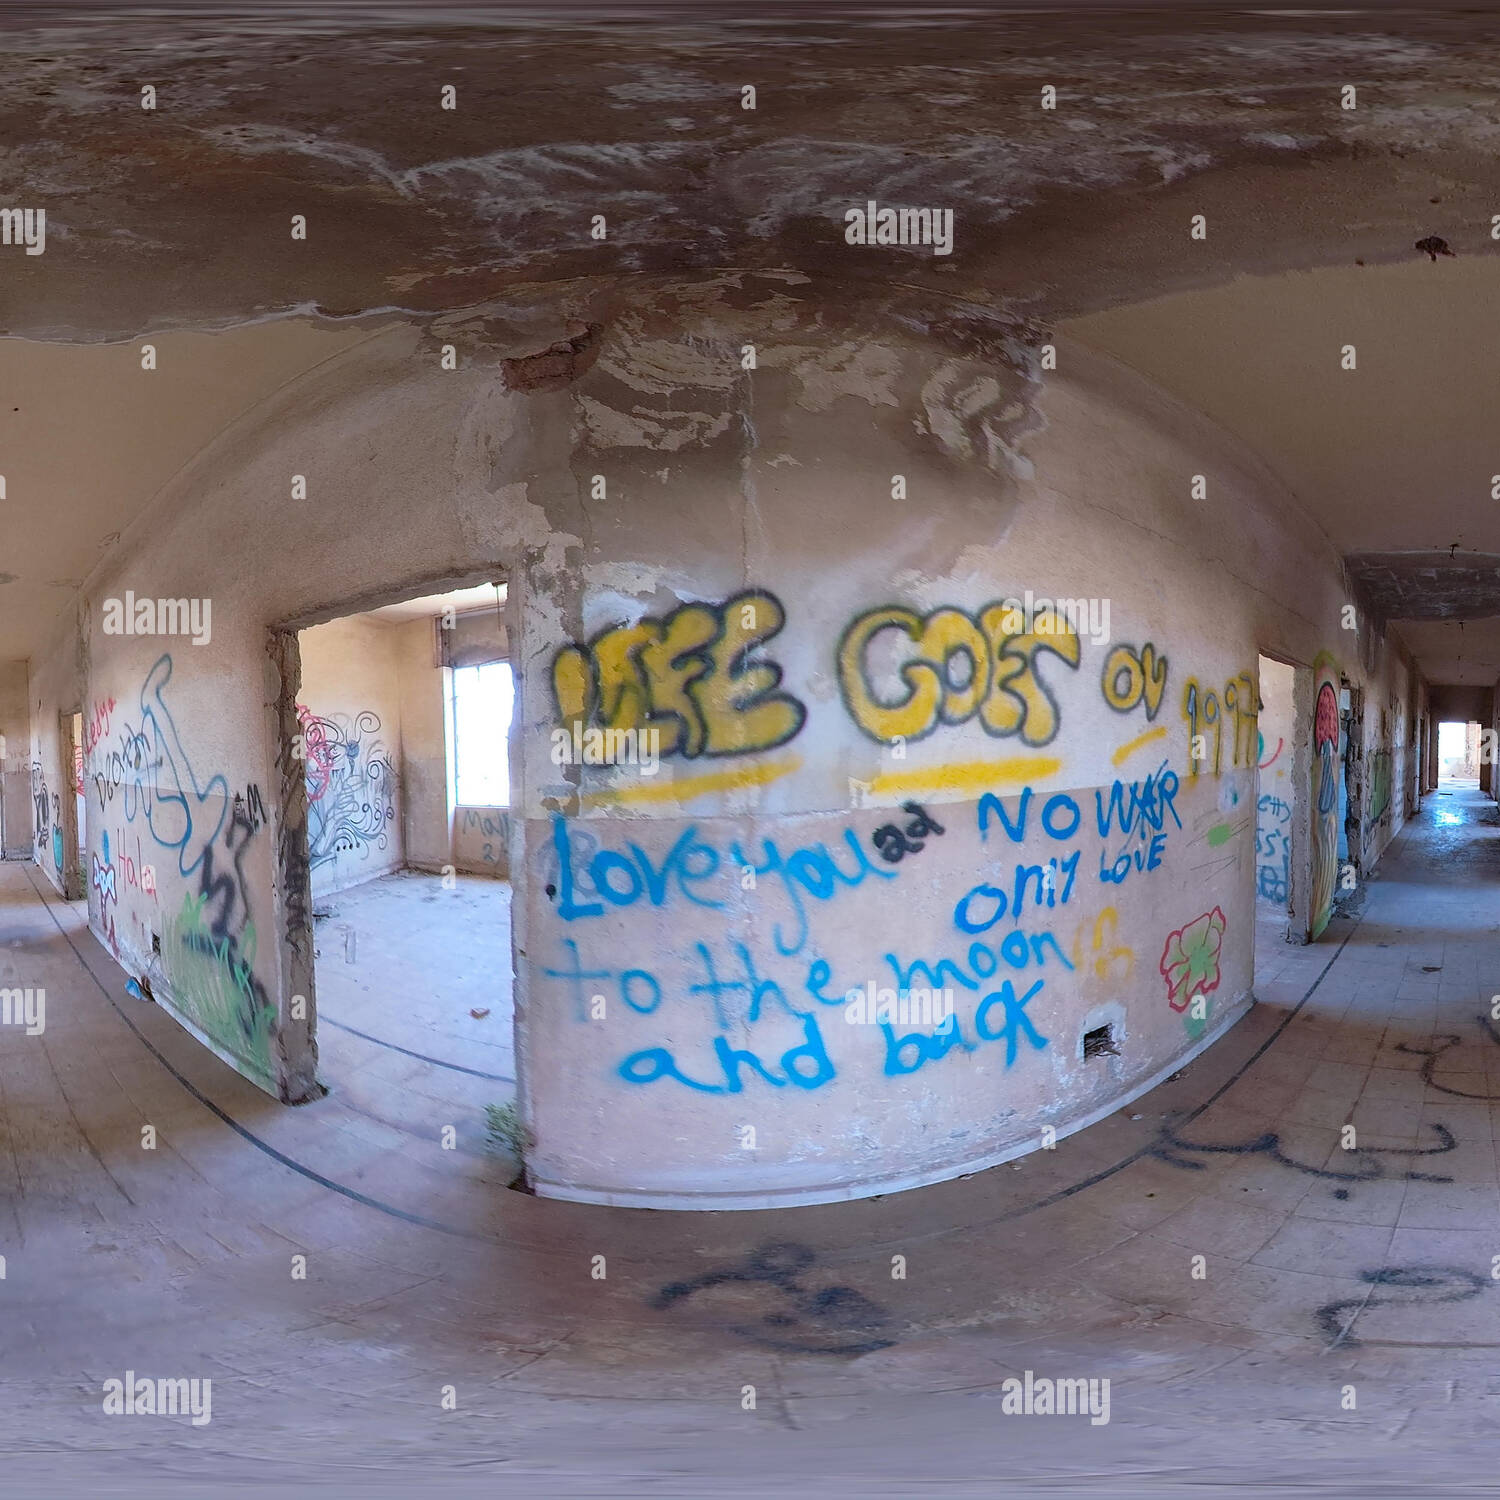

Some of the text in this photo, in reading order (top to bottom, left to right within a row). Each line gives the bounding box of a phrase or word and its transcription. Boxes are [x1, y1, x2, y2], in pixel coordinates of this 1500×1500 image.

[978, 787, 1081, 843] NO
[731, 826, 898, 956] you
[544, 937, 662, 1023] to
[689, 940, 852, 1030] the
[885, 929, 1076, 999] moon
[616, 1012, 837, 1094] and
